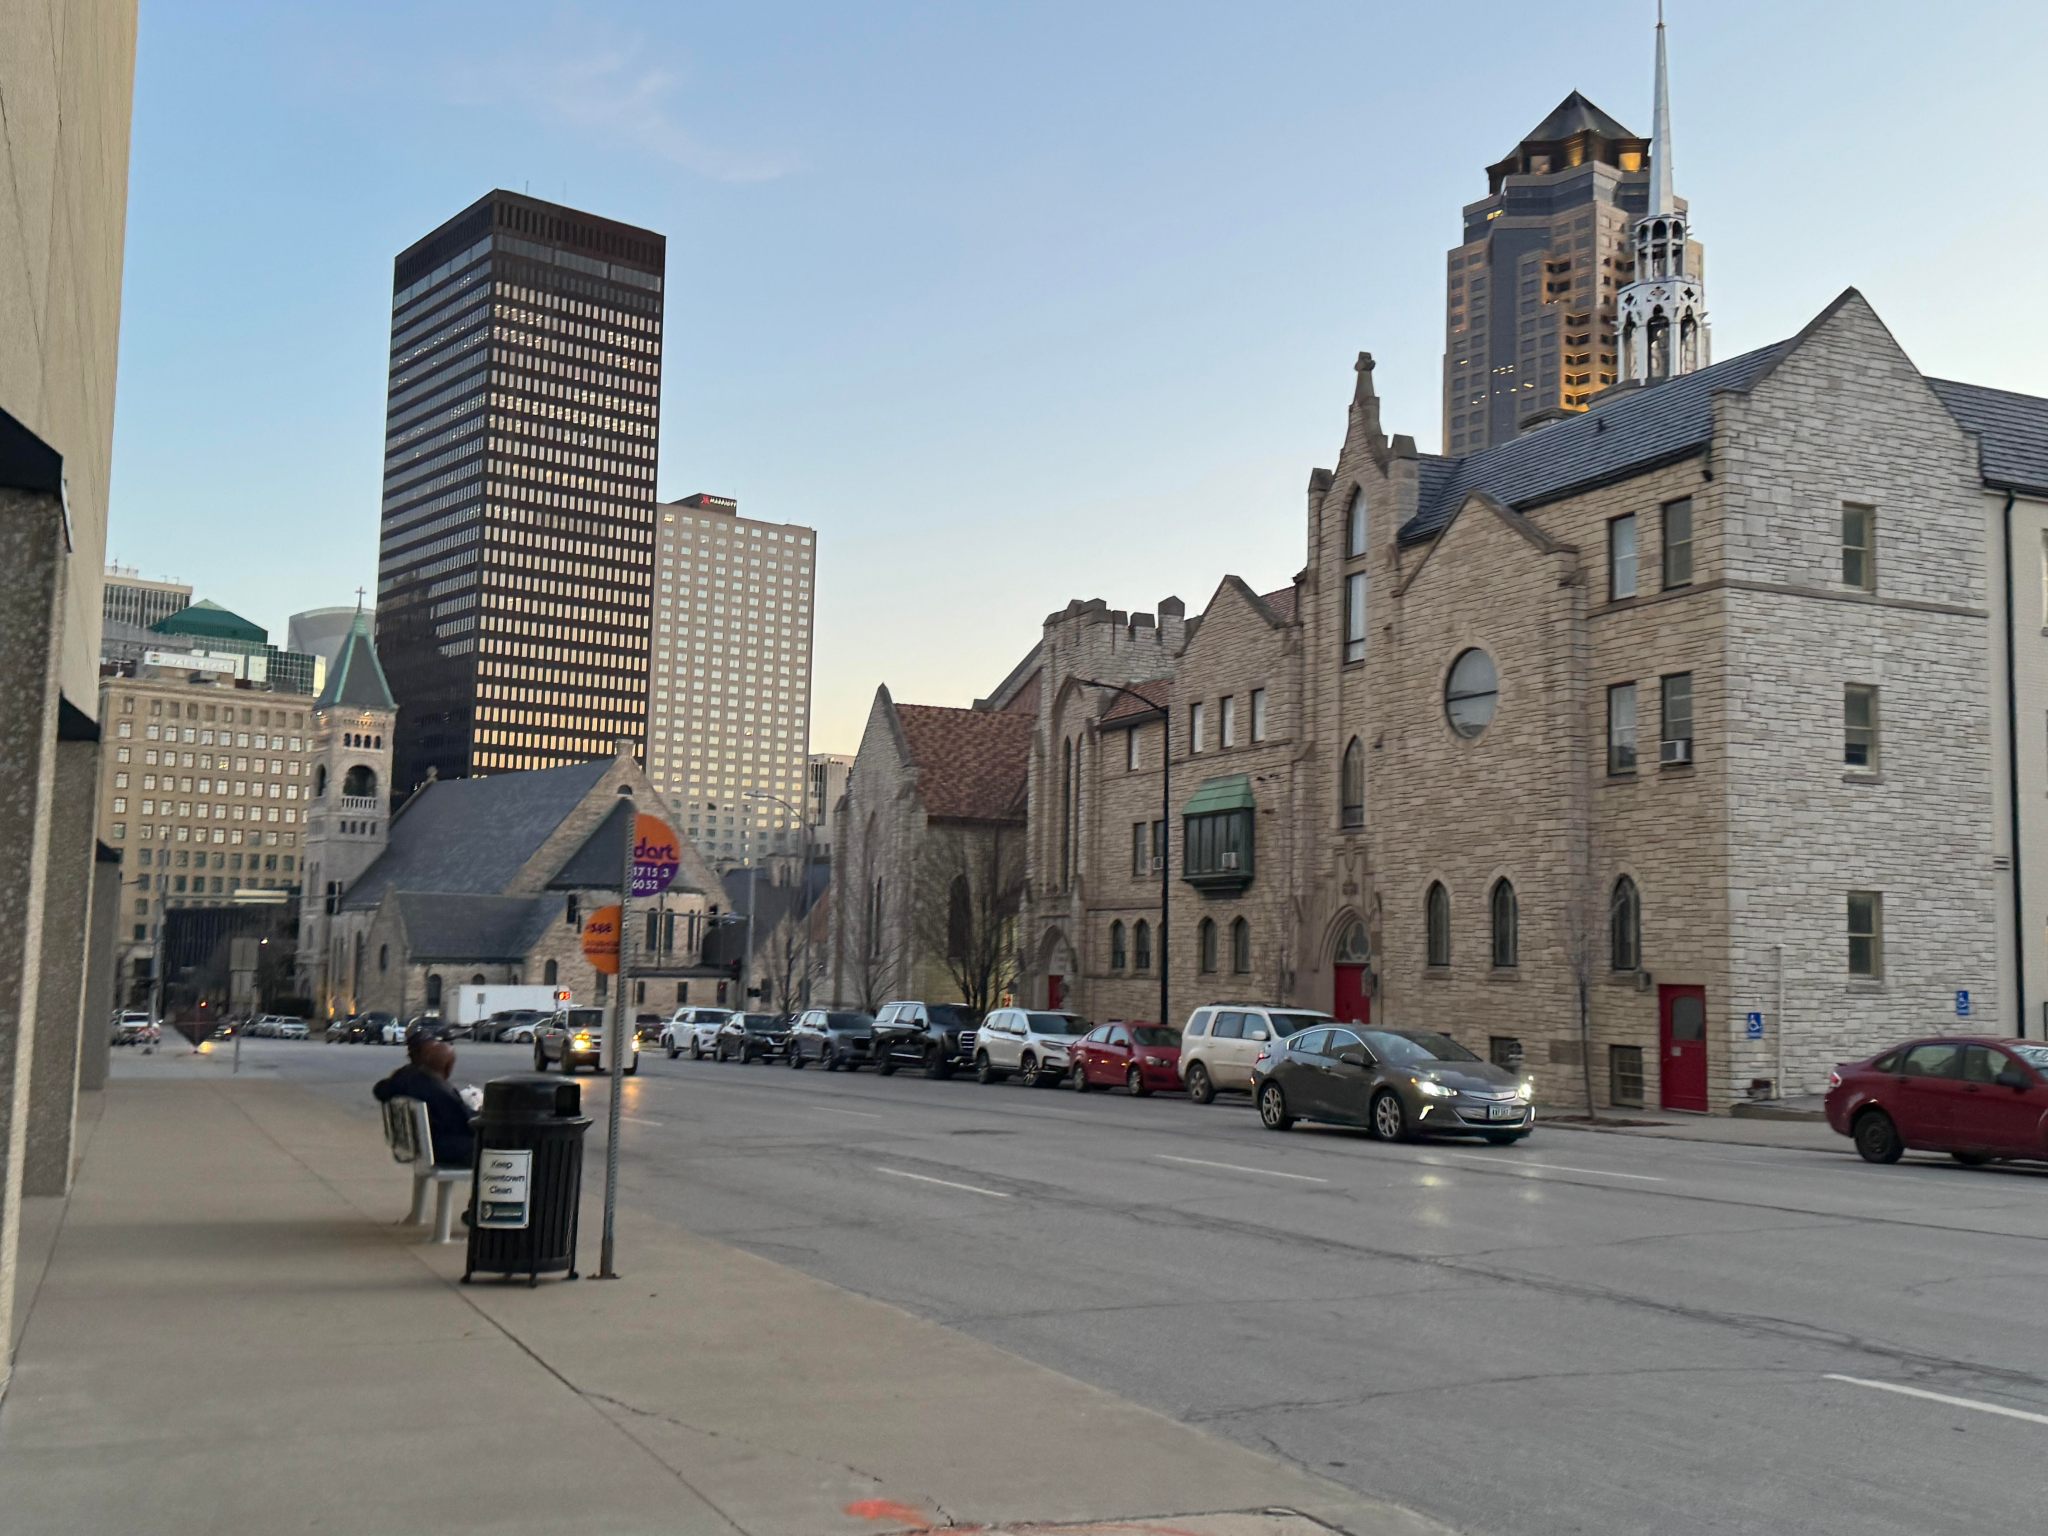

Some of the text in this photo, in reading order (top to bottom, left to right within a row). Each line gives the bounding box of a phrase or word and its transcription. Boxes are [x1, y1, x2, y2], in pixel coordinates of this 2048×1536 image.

[634, 837, 678, 861] dart
[633, 866, 669, 878] 17 15 3
[632, 879, 658, 890] 60 52
